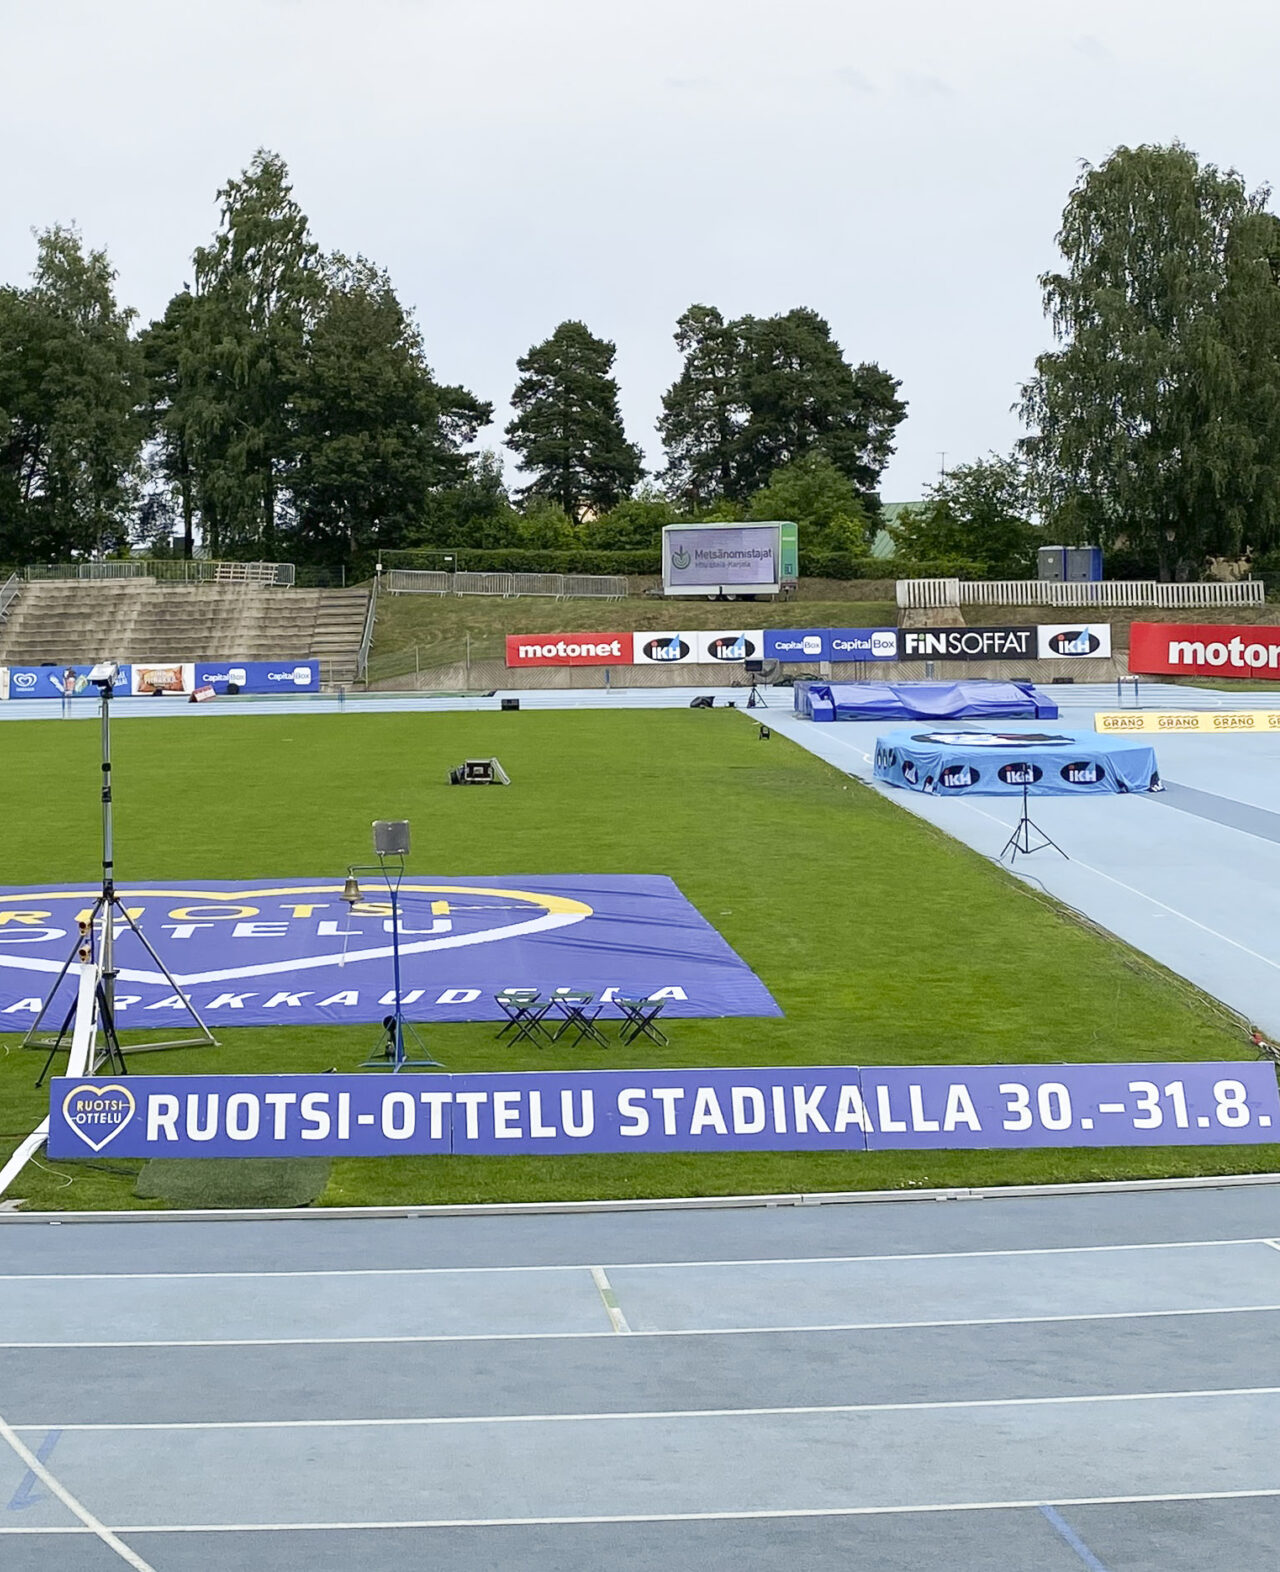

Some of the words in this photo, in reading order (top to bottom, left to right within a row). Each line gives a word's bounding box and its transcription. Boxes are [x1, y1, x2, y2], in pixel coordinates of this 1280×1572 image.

[694, 549, 772, 560] Metsänomistajat
[519, 640, 621, 658] motonet
[775, 639, 820, 651] CapitalBox
[833, 638, 895, 652] CapitalBox
[1103, 718, 1145, 727] GRANO
[1158, 718, 1199, 726] GRANO
[1213, 717, 1255, 726] GRANO
[146, 1089, 594, 1142] RUOTSI-OTTELU
[619, 1083, 982, 1137] STADIKALLA
[999, 1079, 1272, 1132] 30.-31.8.
[76, 1112, 122, 1124] OTTELU
